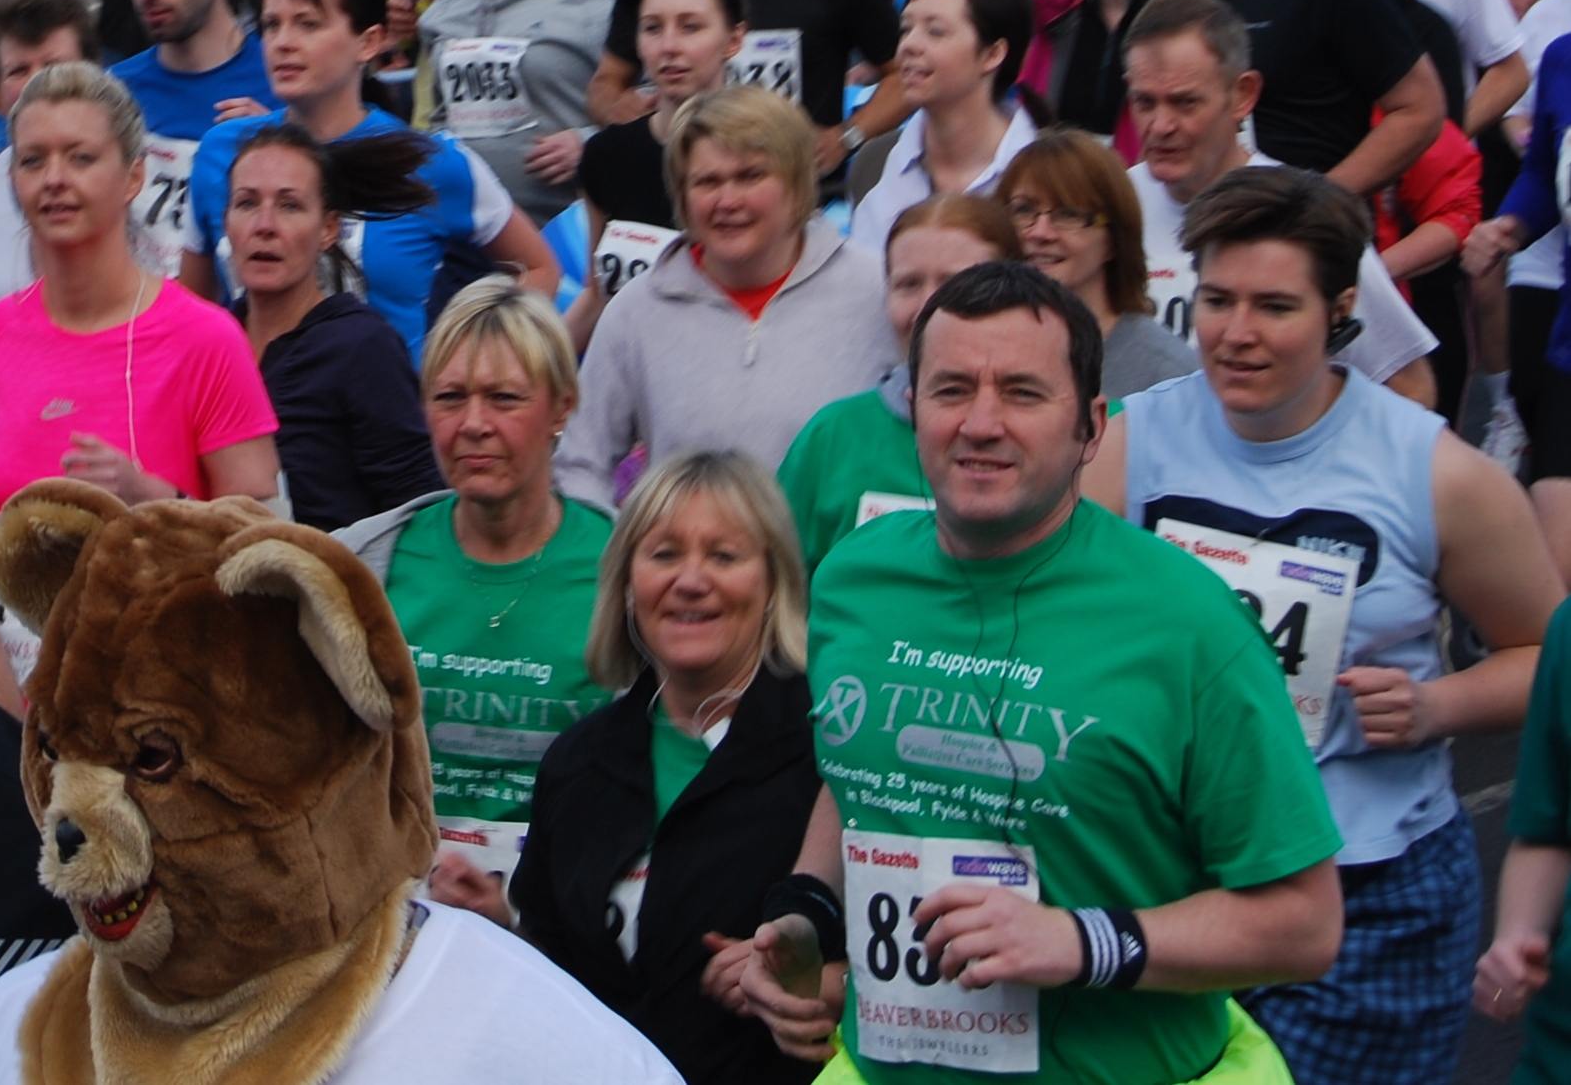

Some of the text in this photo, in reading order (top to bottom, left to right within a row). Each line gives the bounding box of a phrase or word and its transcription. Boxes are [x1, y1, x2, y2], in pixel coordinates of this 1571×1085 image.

[441, 650, 554, 685] supporting
[888, 640, 1044, 691] I'm supporting
[879, 682, 1101, 763] TRINITY
[886, 772, 907, 790] 25
[910, 779, 948, 797] years
[1030, 797, 1070, 819] Care
[847, 845, 920, 870] The Gazette
[857, 993, 1030, 1036] BEAVERBROOKS
